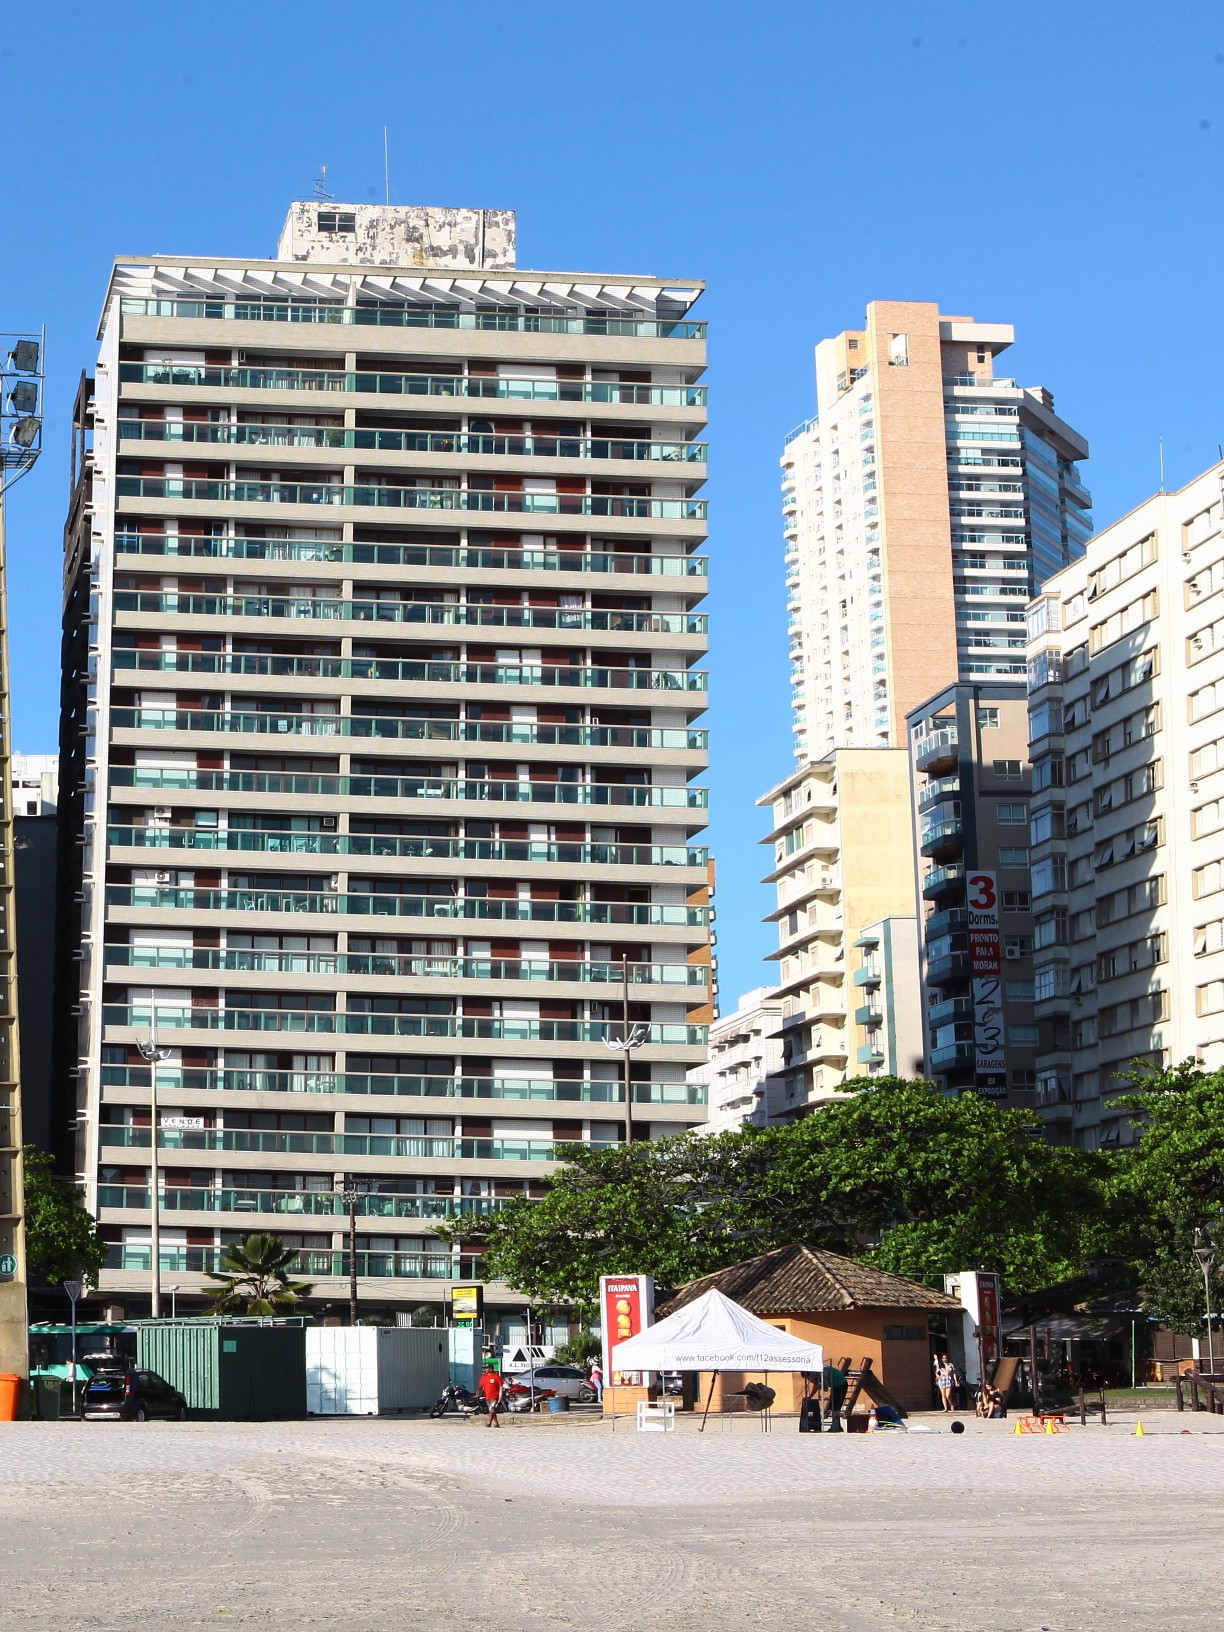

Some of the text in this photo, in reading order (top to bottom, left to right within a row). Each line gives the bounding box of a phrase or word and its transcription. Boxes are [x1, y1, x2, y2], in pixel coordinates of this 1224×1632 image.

[968, 875, 997, 910] 3
[968, 910, 999, 925] Dorms.
[969, 933, 999, 943] PRONTO
[973, 960, 998, 970] MORAR
[975, 979, 1000, 1006] 2
[978, 1026, 1001, 1056] 3
[976, 1059, 1006, 1069] GARAGENS
[607, 1284, 638, 1293] ITAIPAVA
[674, 1353, 812, 1365] www.facebook.com/f12assessoria
